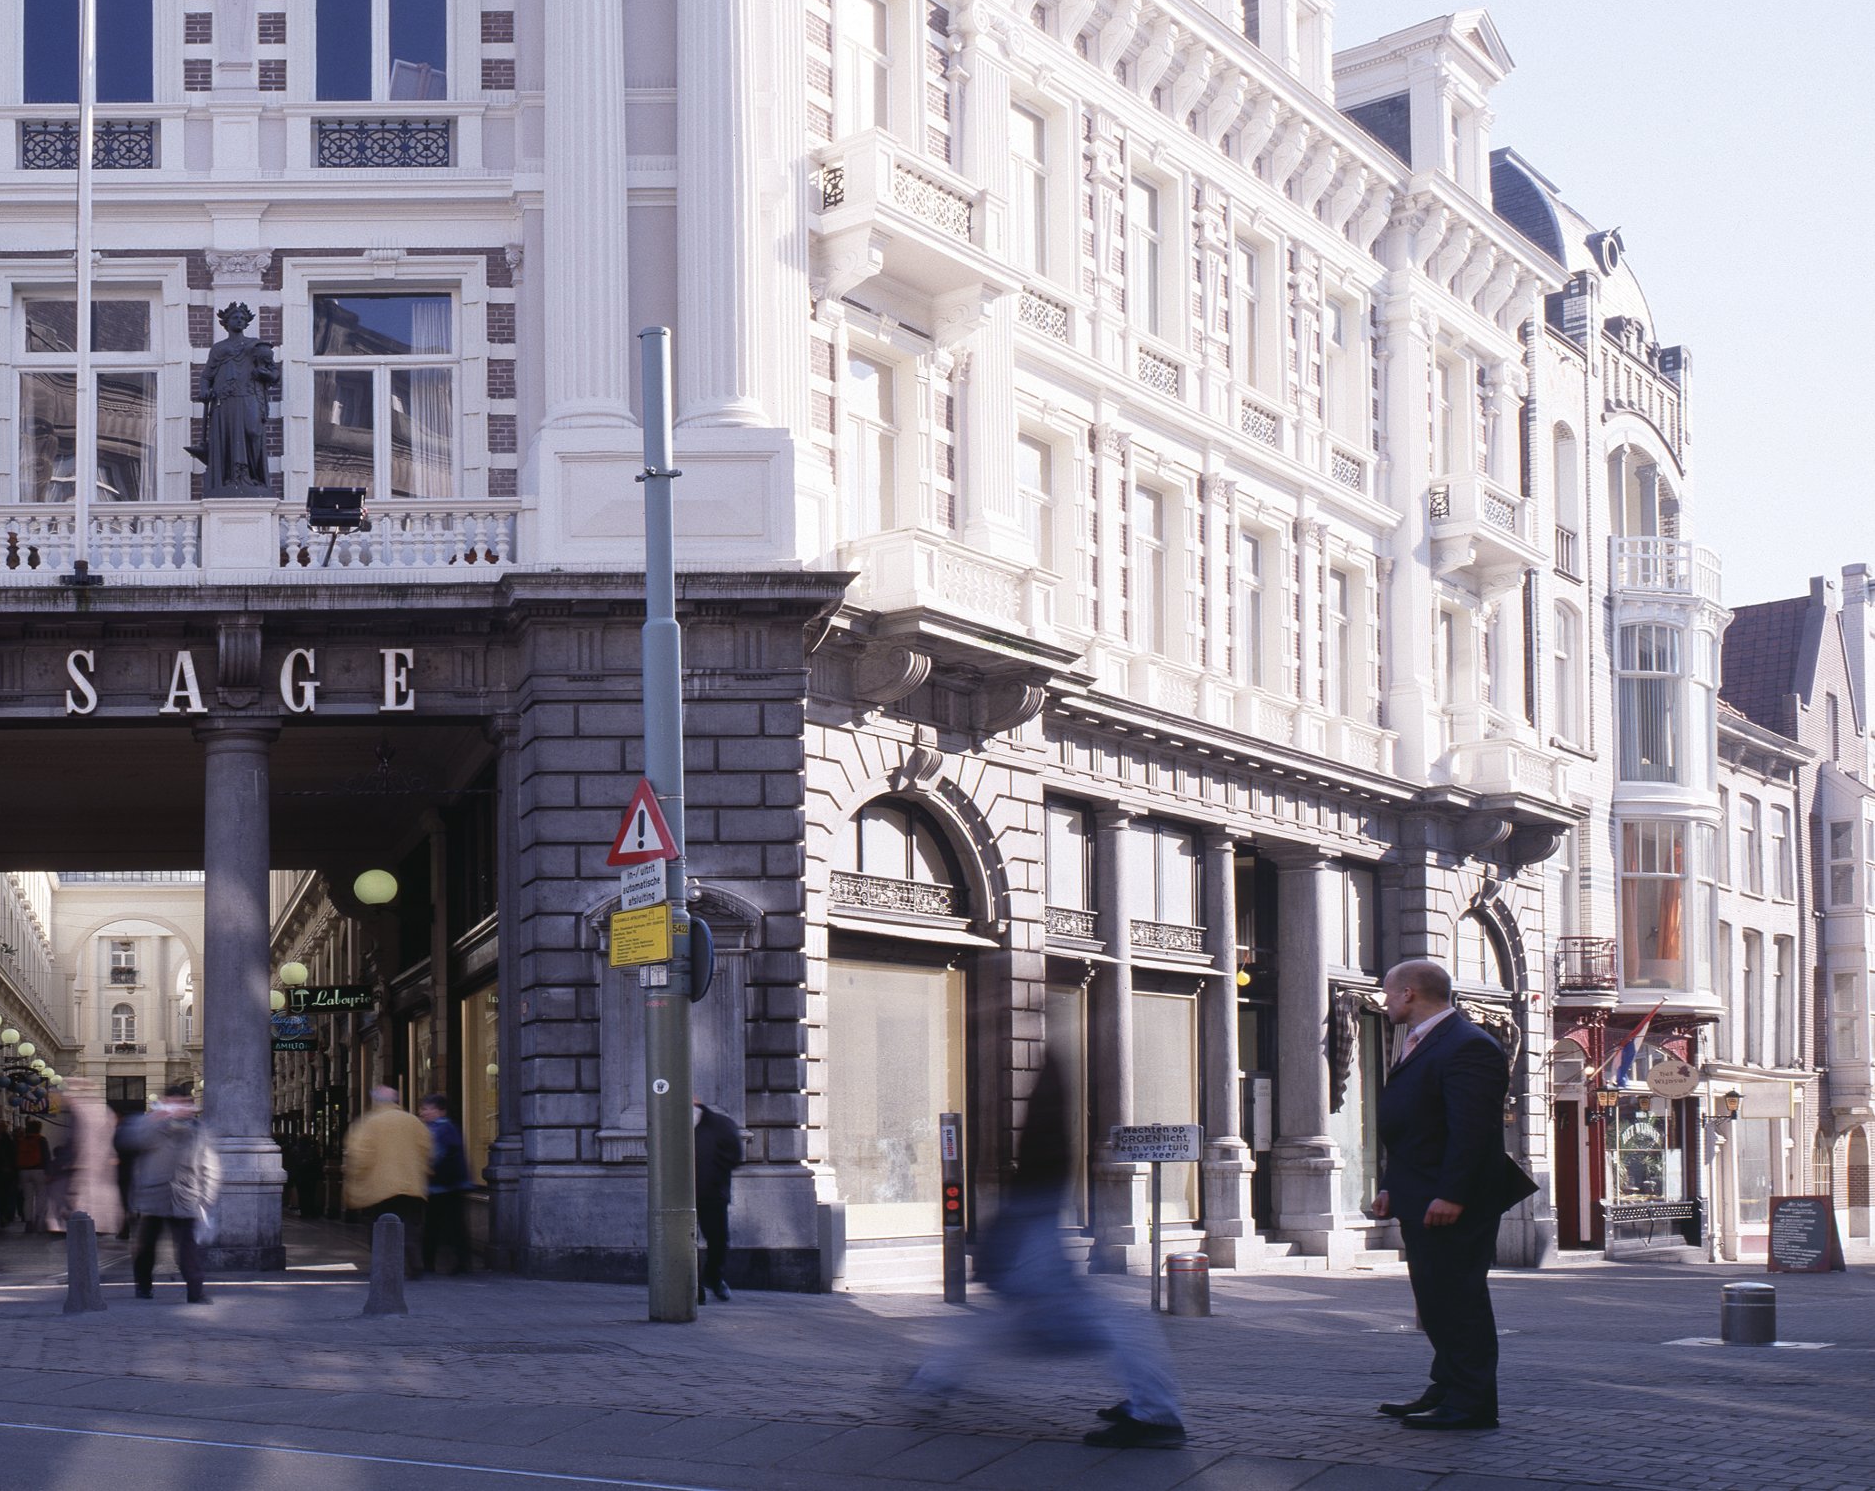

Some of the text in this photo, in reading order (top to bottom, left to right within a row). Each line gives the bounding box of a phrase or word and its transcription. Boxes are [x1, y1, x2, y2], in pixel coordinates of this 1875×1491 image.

[623, 876, 660, 895] automatische
[628, 891, 655, 906] afsluiting
[312, 989, 372, 1007] Laboyrie
[1123, 1126, 1185, 1135] Wachten op
[1121, 1135, 1161, 1143] GROEN
[1143, 1143, 1189, 1152] voertuig
[1132, 1151, 1177, 1161] per keer
